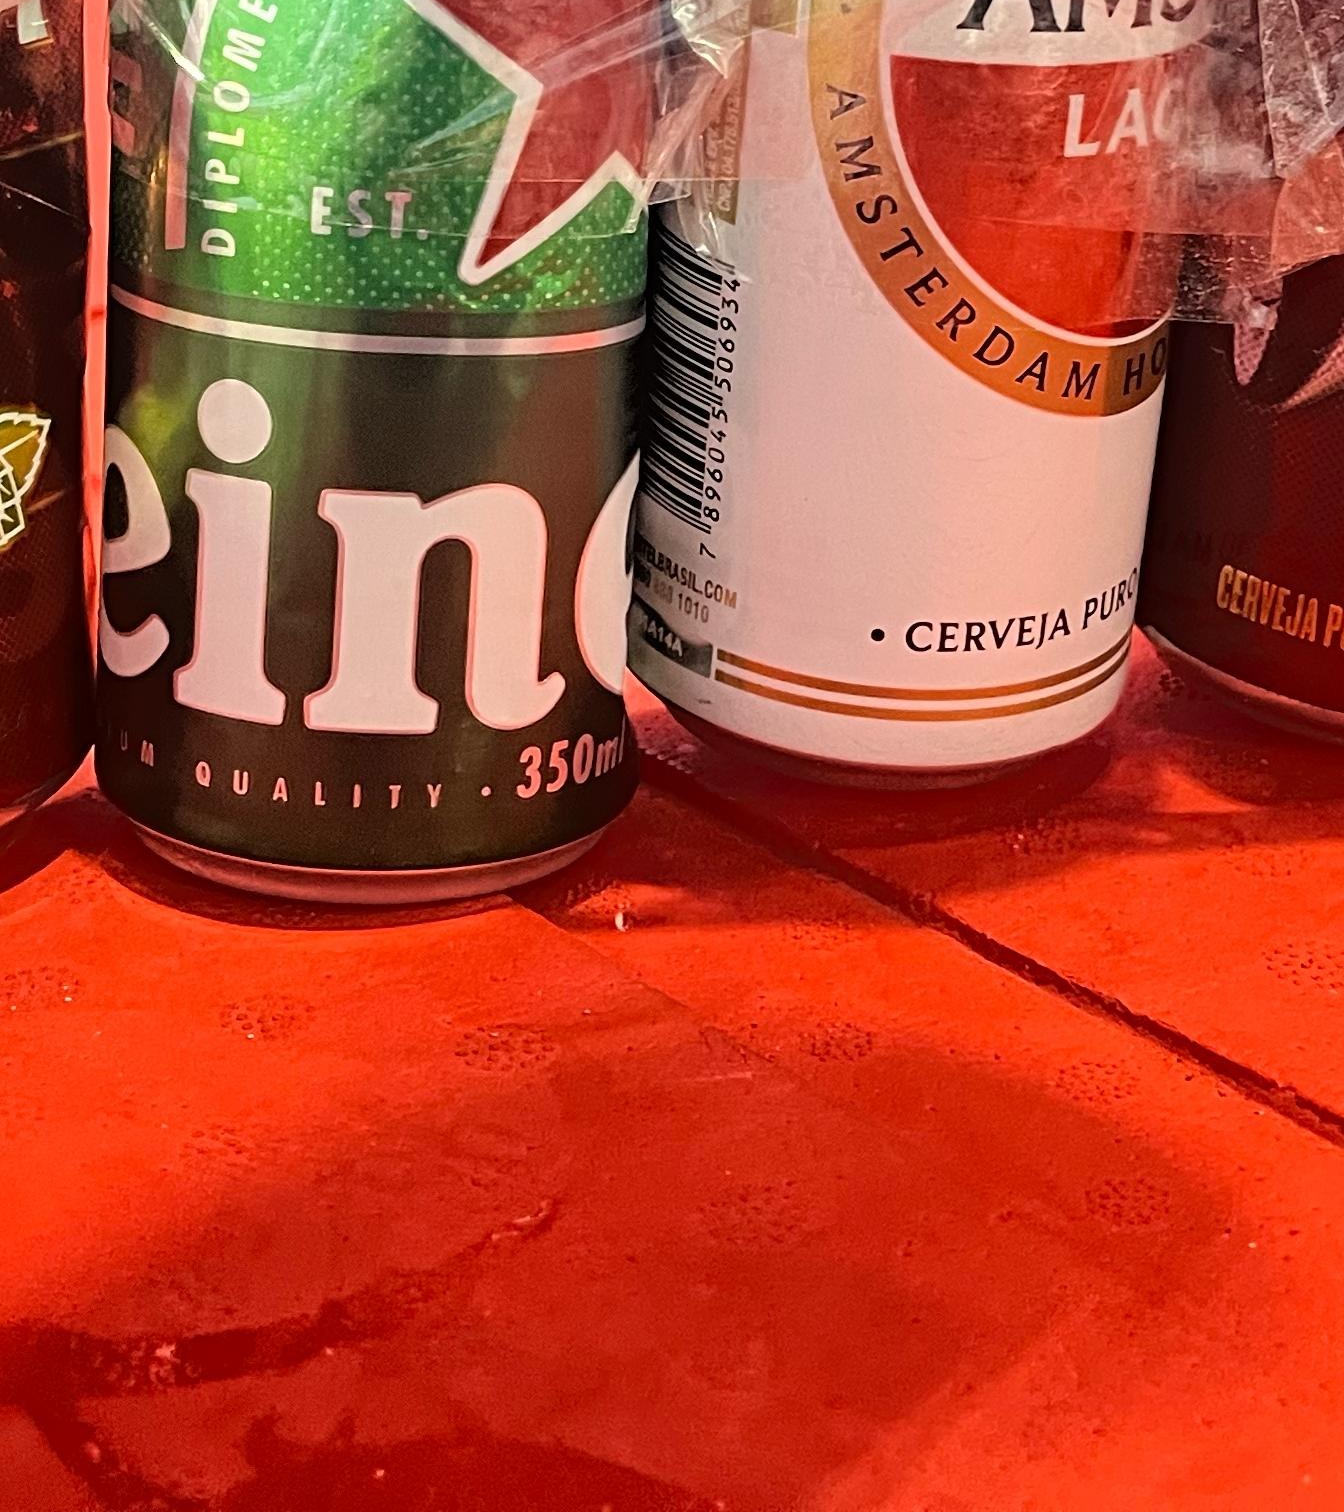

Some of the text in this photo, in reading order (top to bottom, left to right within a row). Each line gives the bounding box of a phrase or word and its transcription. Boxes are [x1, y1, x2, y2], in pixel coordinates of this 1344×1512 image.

[309, 185, 430, 240] EST.
[825, 83, 1100, 401] AMSTERDAM
[699, 276, 741, 559] 7 896045 506934
[904, 609, 1072, 654] CERVEJA
[1216, 564, 1318, 642] CERVEJA
[196, 732, 626, 808] QUALITY 350ml
